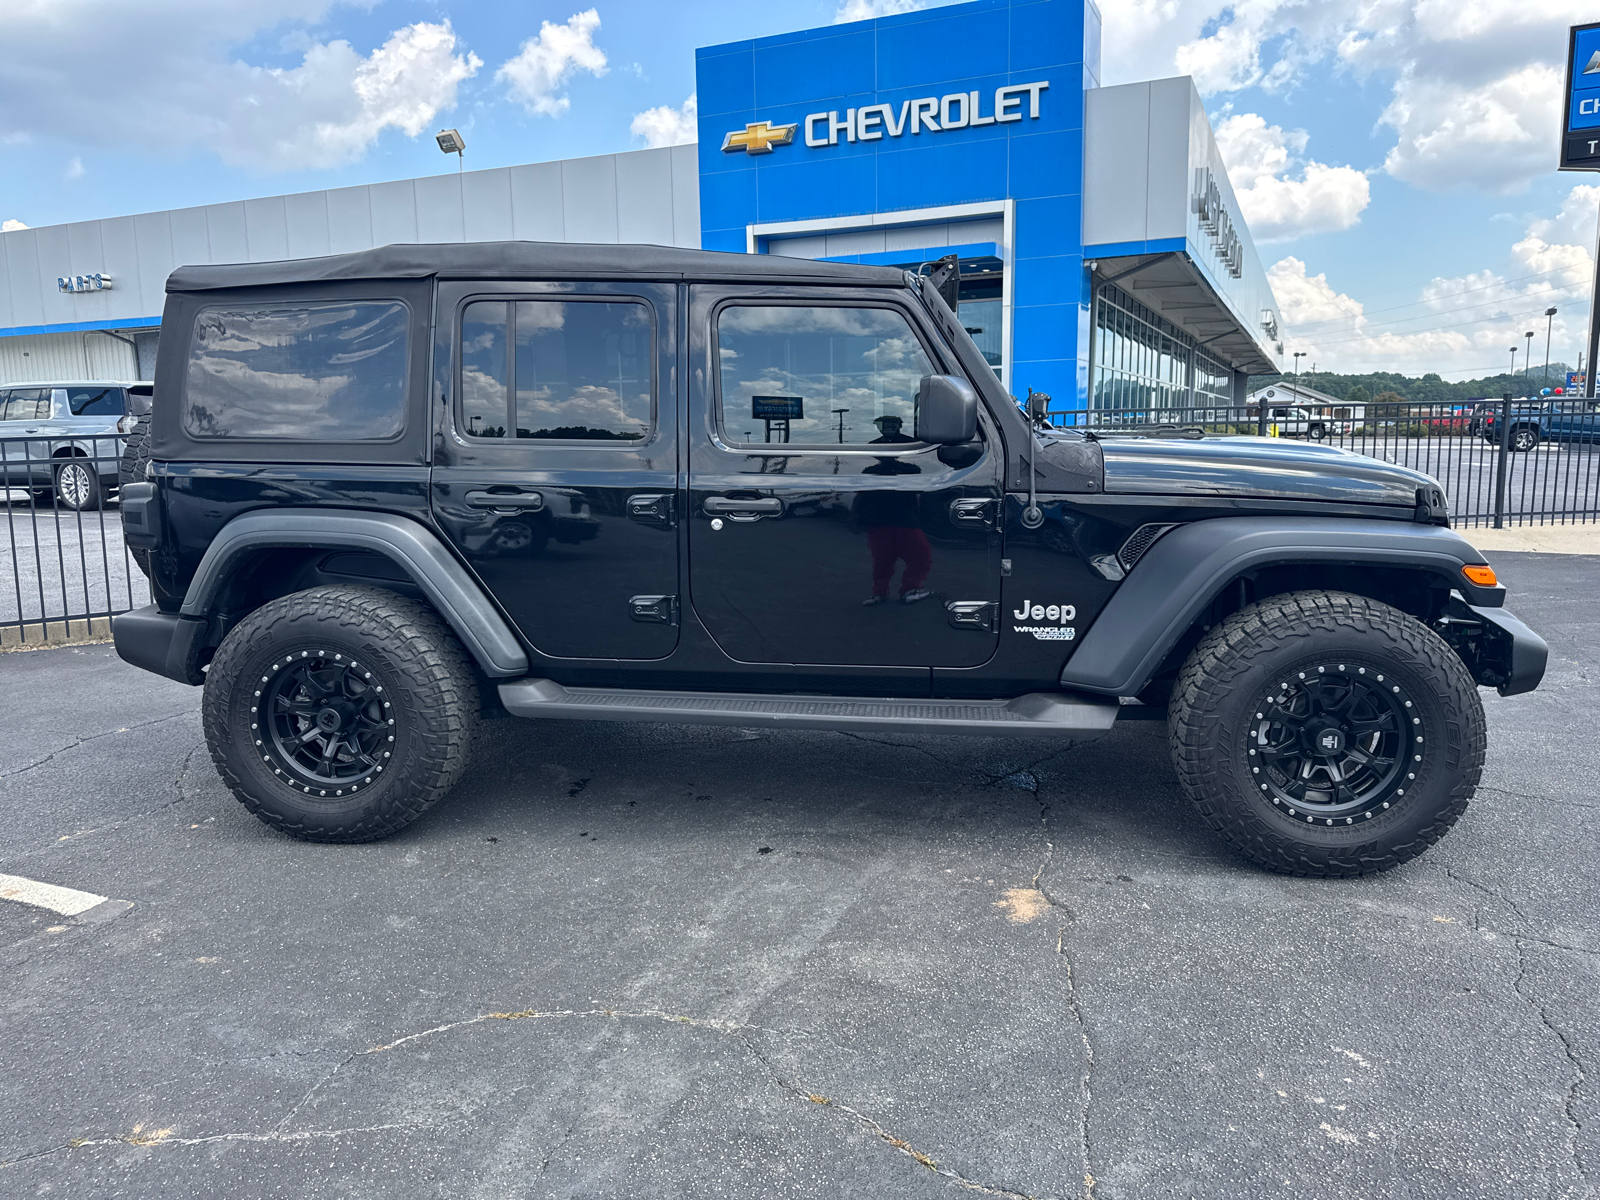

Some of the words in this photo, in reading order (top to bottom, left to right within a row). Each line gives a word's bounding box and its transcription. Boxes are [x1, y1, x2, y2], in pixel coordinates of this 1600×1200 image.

[804, 80, 1050, 148] CHEVROLET
[1587, 140, 1599, 154] T
[57, 273, 104, 293] PARTS
[1013, 600, 1076, 624] Jeep
[1382, 645, 1461, 772] FALKEN
[1222, 782, 1379, 860] WILDPEAK
